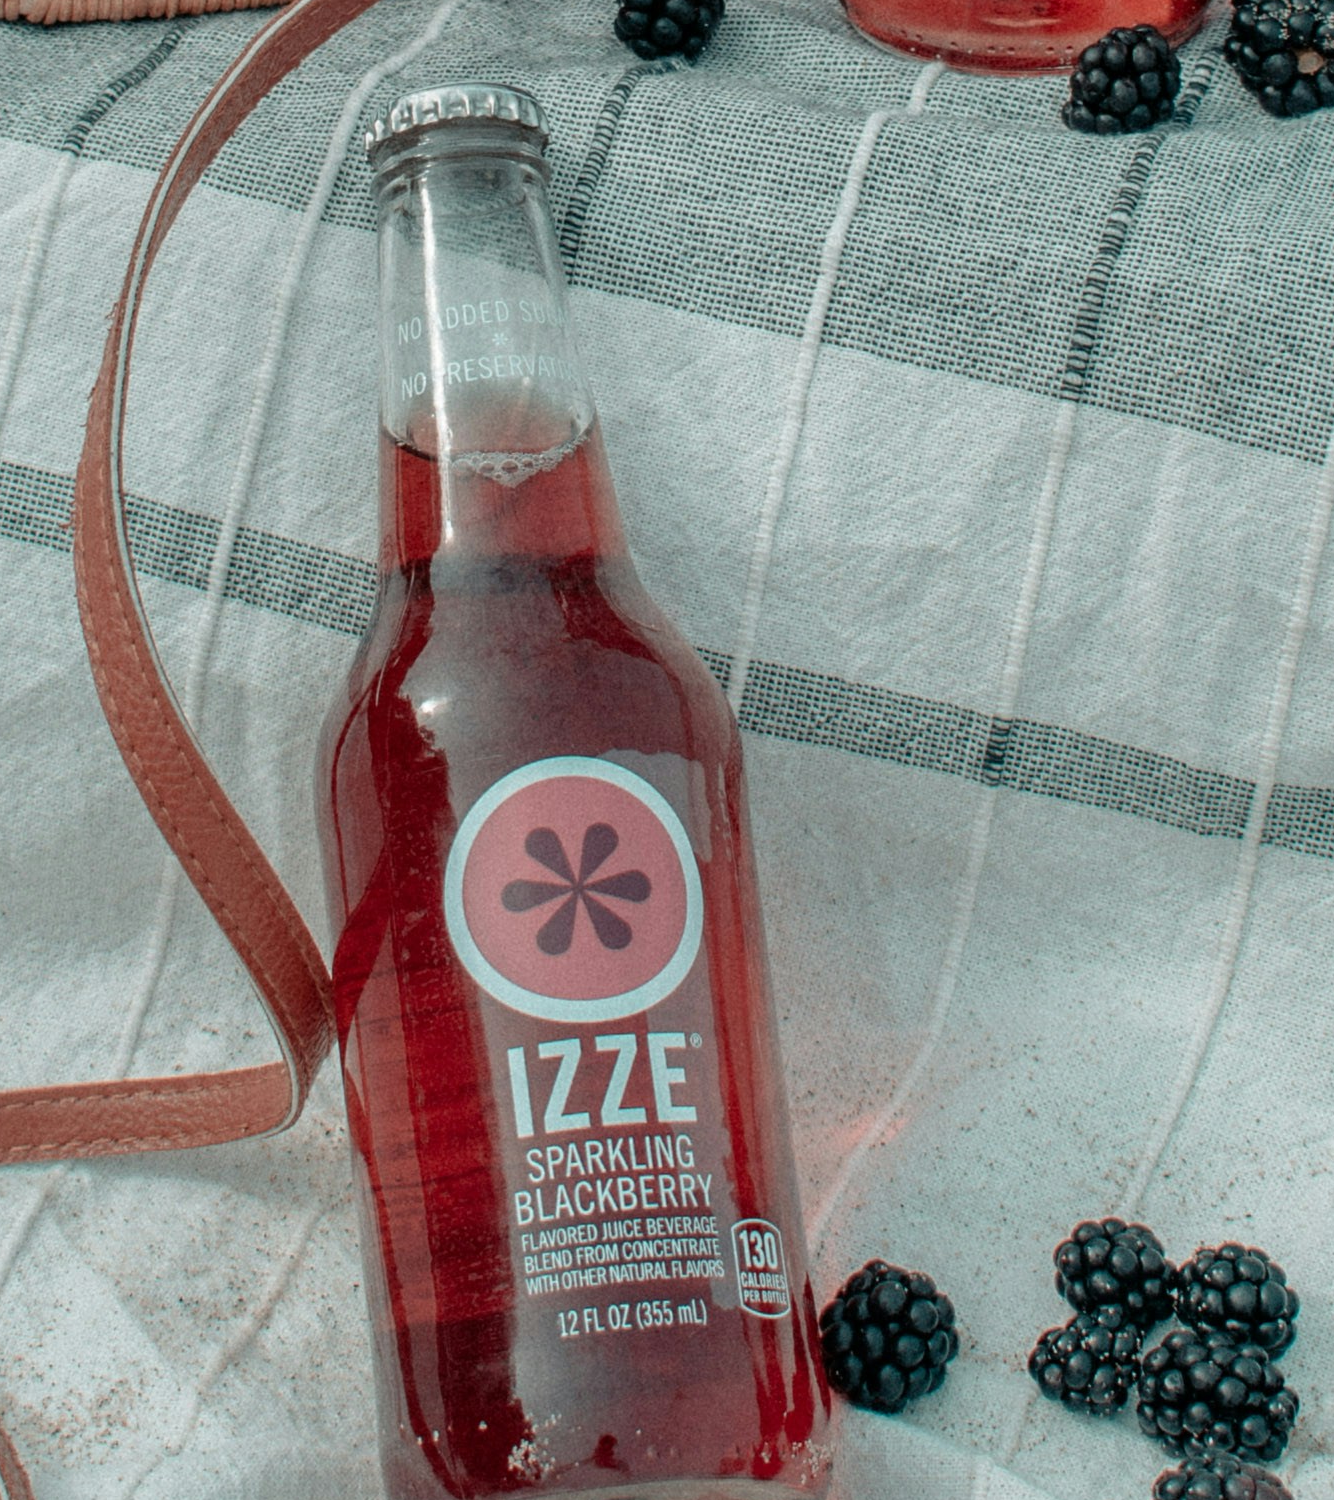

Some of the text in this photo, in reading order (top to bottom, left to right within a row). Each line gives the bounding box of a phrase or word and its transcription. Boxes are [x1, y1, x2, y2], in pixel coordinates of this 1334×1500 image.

[397, 316, 422, 345] NO
[401, 371, 427, 401] NO
[526, 1134, 695, 1183] SPARKLING
[514, 1174, 713, 1225] BLACKBERRY
[521, 1216, 719, 1252] FLAVORED JUICE BEVERAGE
[739, 1229, 778, 1270] 130
[524, 1238, 722, 1275] BLEND FROM CONCENTRATE
[525, 1259, 725, 1296] WITH OTHER NATURAL FLAVORS
[740, 1271, 786, 1290] CALORIES
[743, 1289, 788, 1306] PER BOTTLE
[557, 1299, 708, 1338] 12 FL OZ (355 mL)
